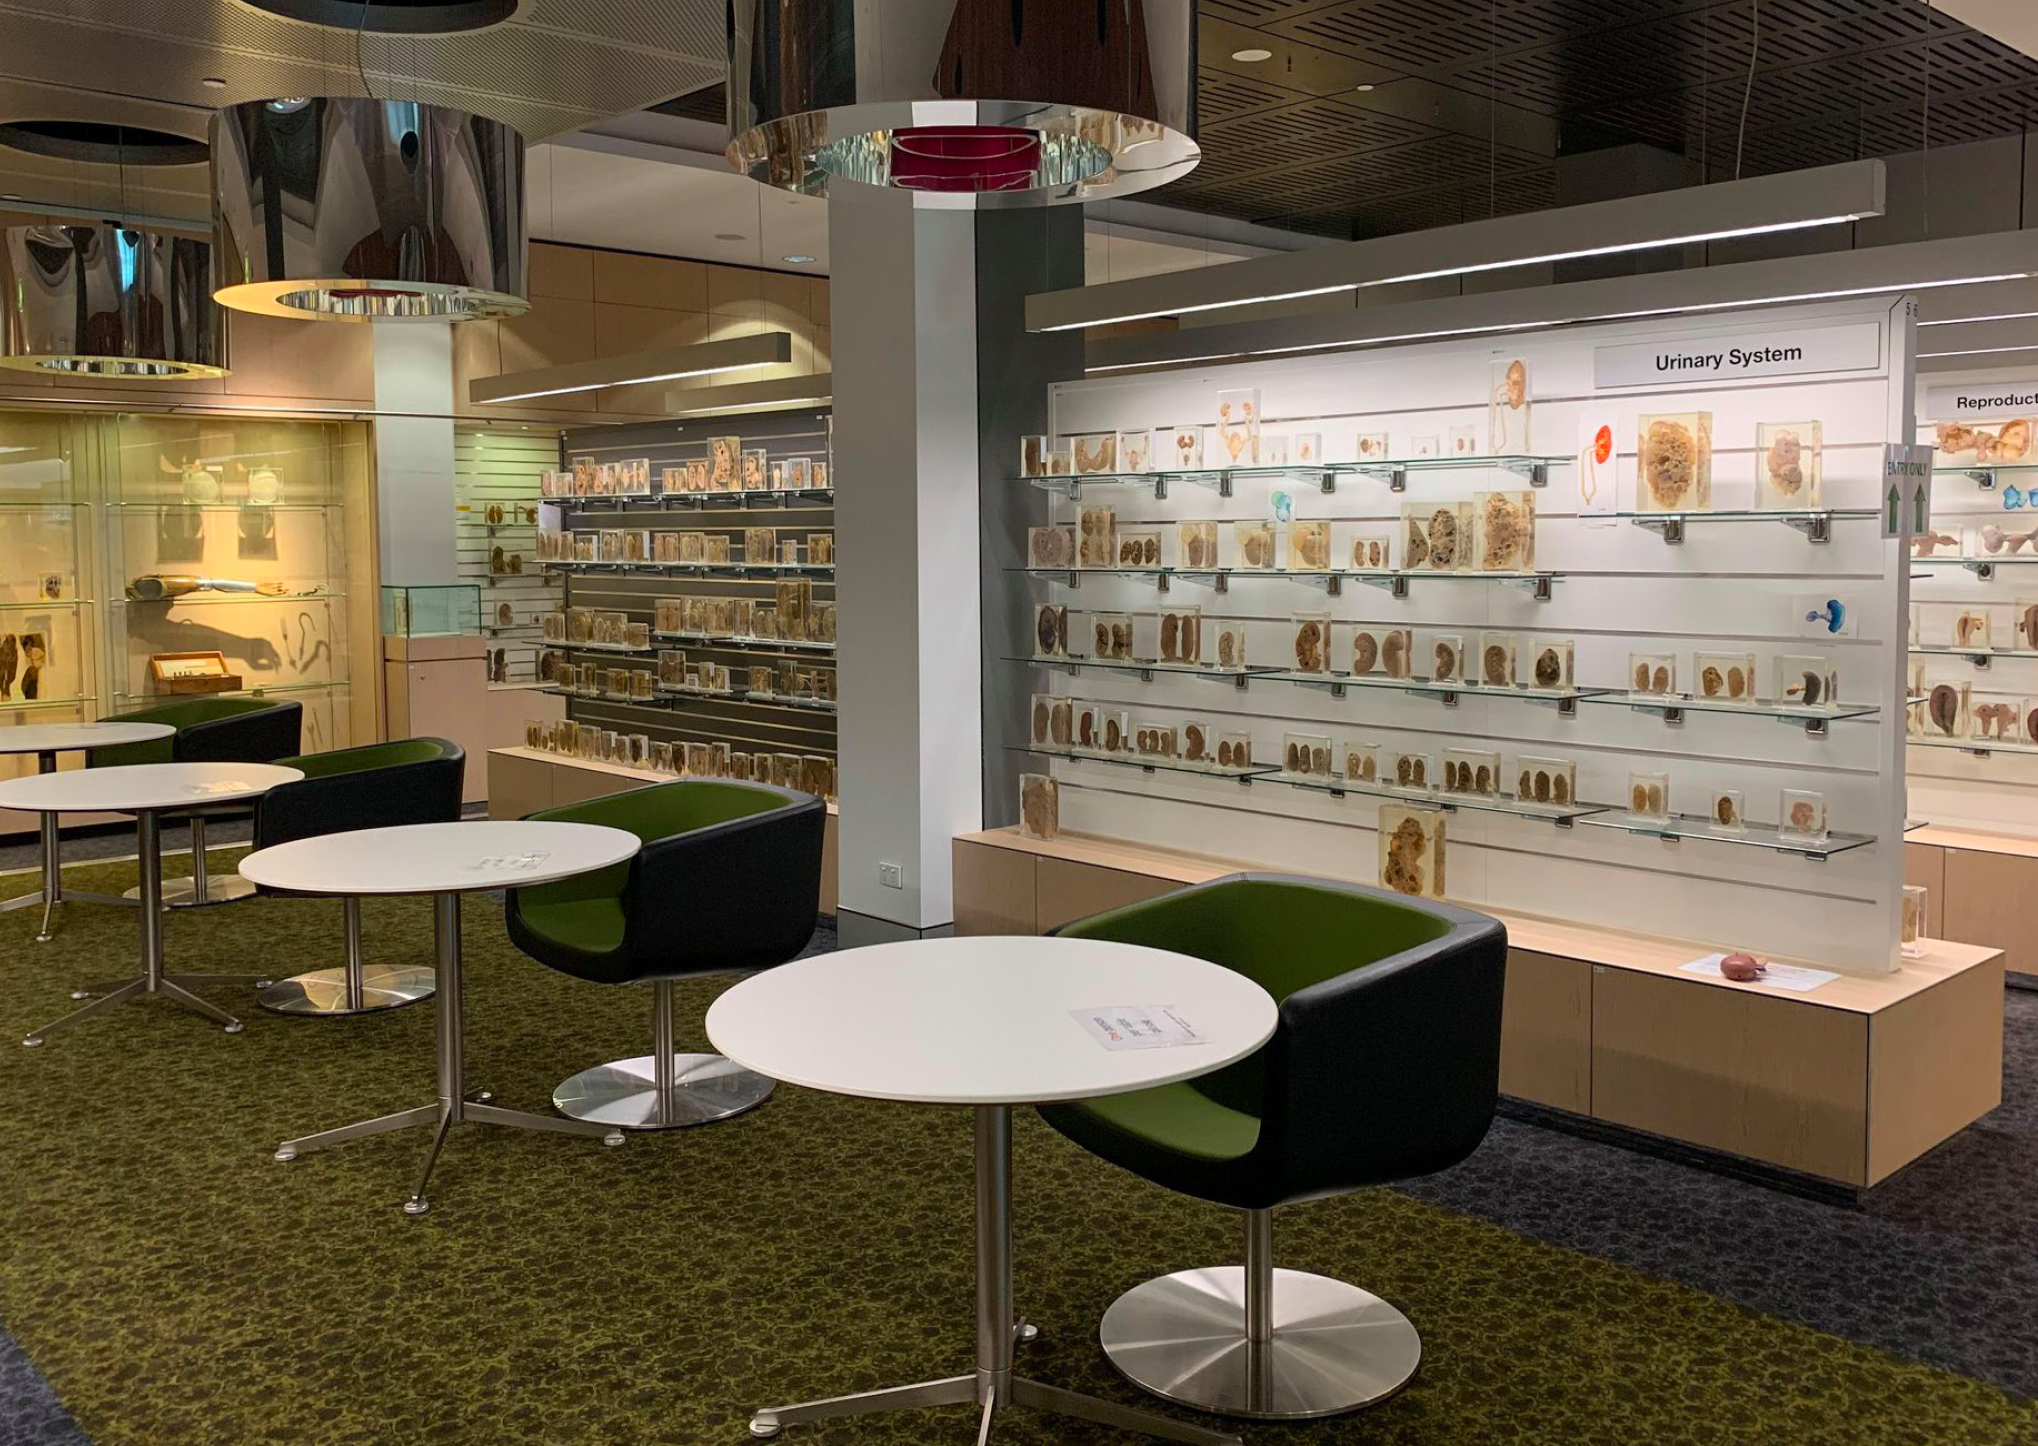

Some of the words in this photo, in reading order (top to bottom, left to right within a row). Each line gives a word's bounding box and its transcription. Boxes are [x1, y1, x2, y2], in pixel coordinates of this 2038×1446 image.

[1906, 302, 1911, 316] 5
[1655, 353, 1723, 371] Urinary
[1728, 347, 1802, 368] System
[1887, 461, 1908, 476] ENTRY
[1909, 462, 1929, 476] ONLY
